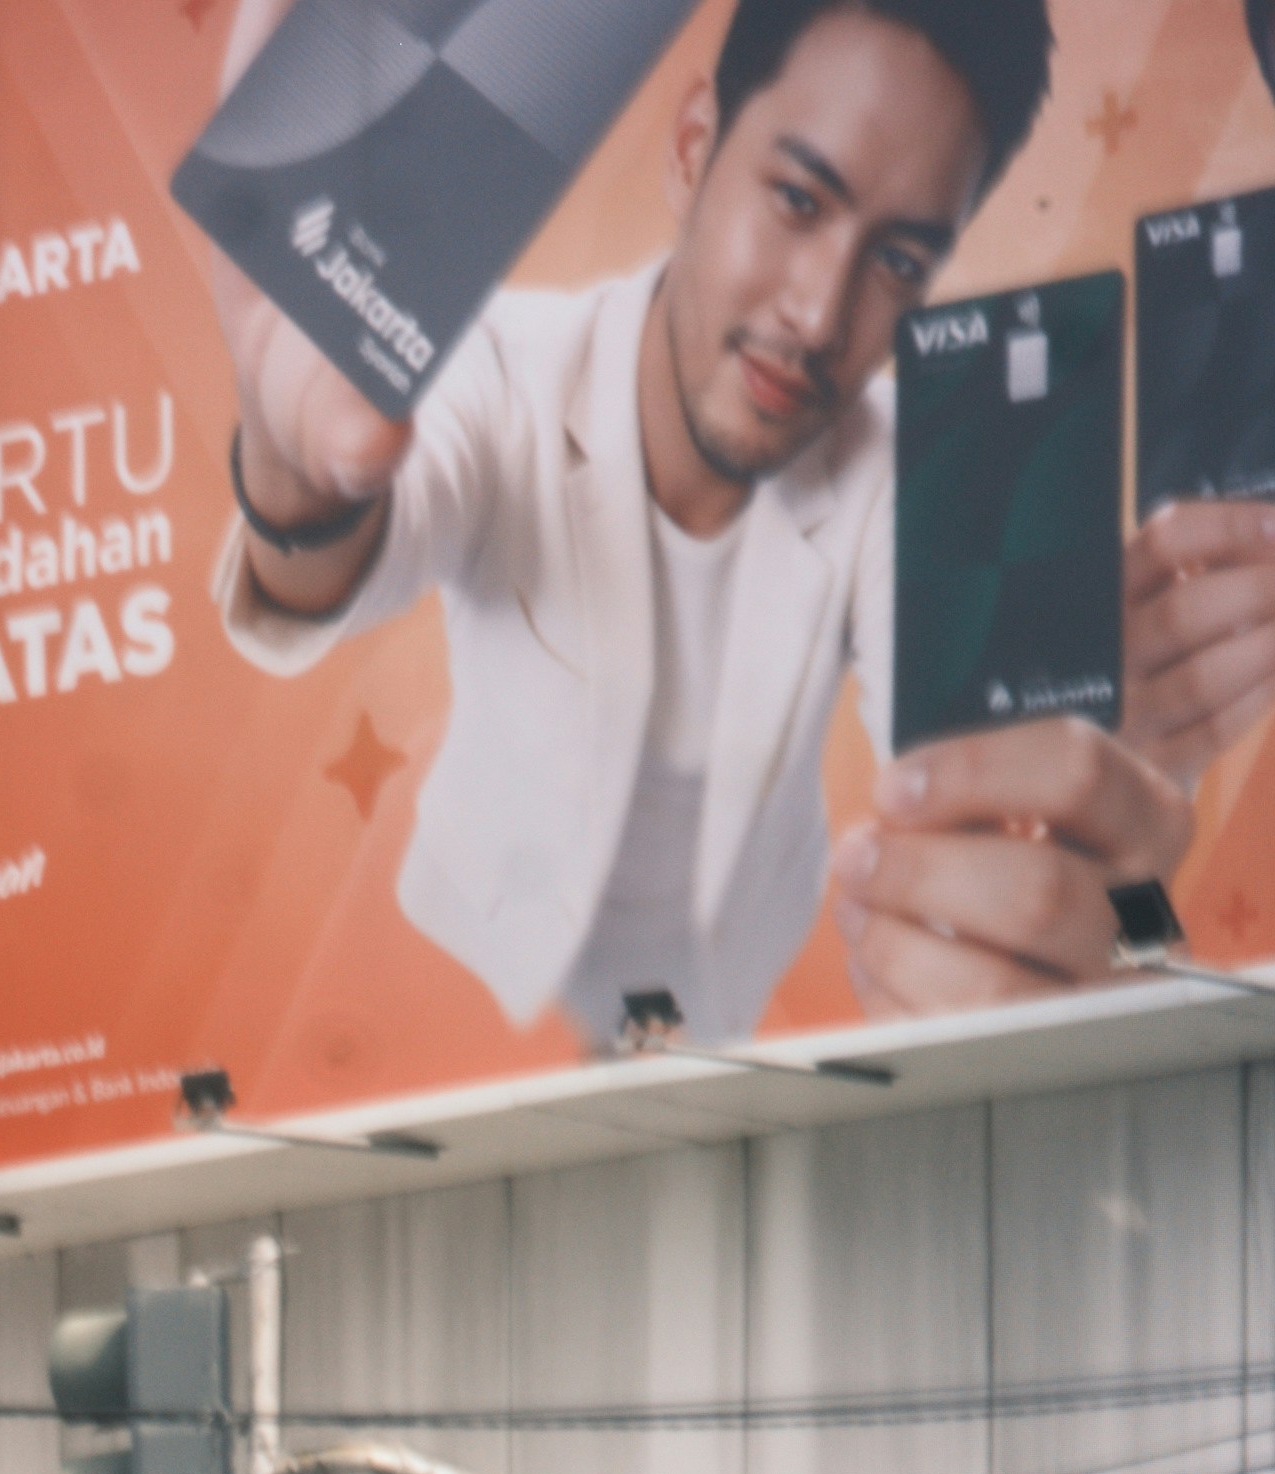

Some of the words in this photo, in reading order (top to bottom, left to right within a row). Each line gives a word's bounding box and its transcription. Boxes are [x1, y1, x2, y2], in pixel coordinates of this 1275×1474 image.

[1145, 212, 1200, 248] VISA
[315, 246, 434, 373] Jakarta
[910, 308, 989, 357] VISA
